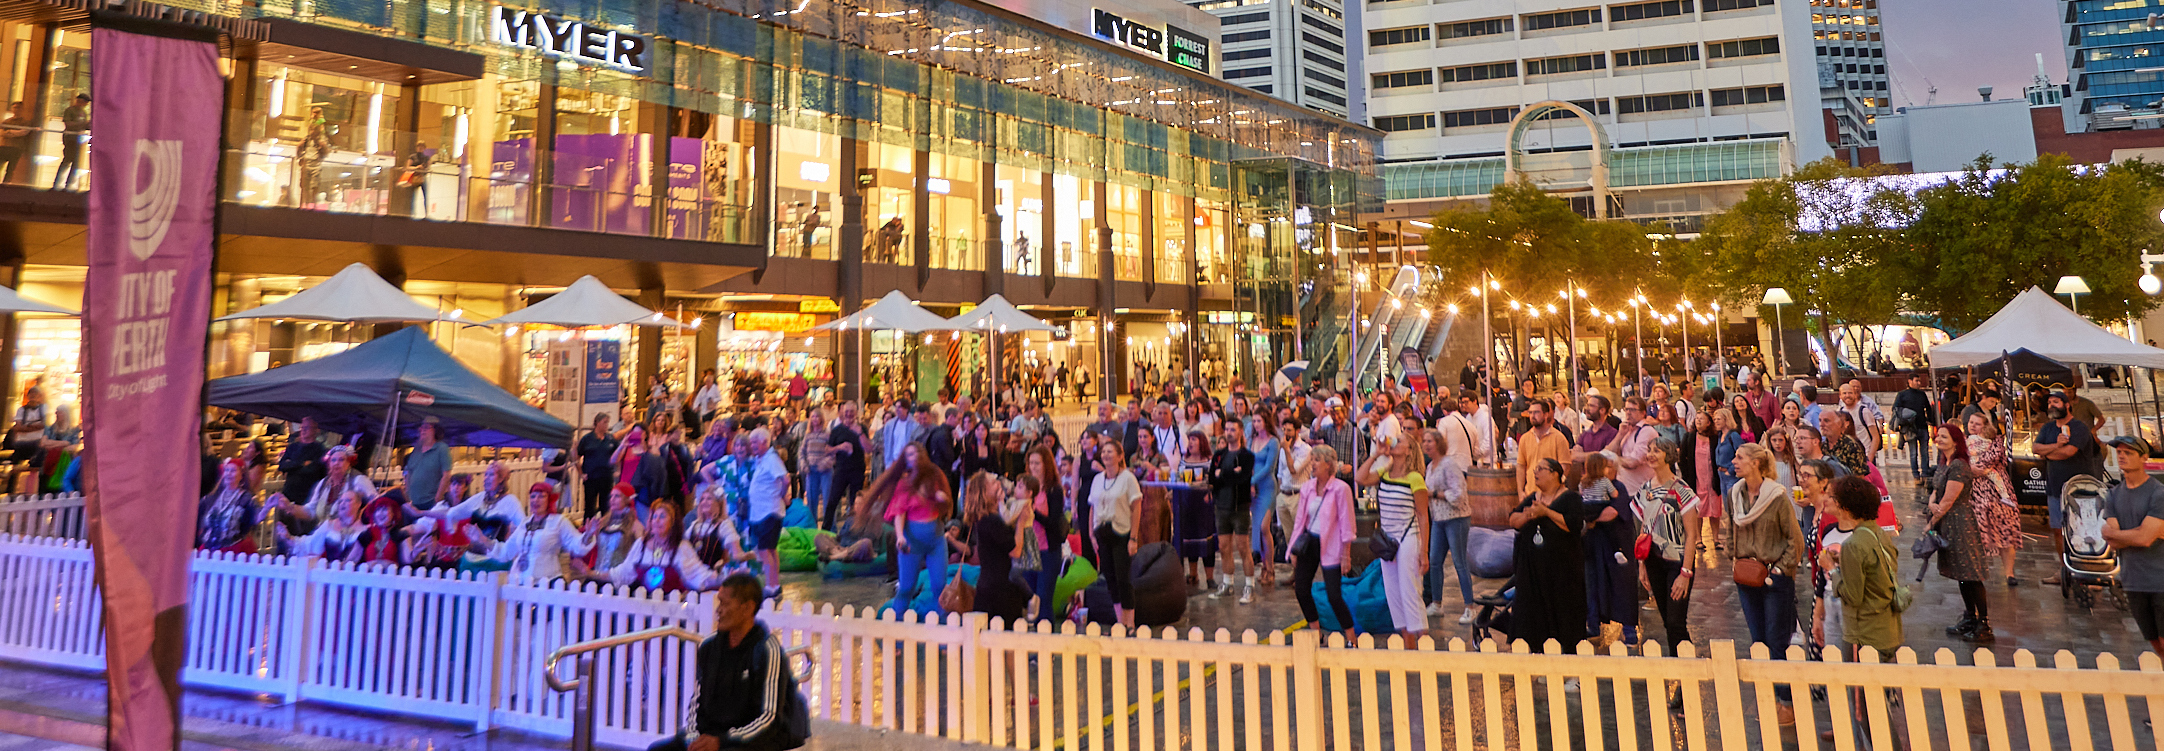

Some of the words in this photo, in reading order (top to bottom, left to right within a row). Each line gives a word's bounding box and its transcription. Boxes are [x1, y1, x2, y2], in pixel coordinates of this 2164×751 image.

[491, 5, 644, 71] MYER
[1090, 7, 1163, 57] MYER
[1174, 34, 1206, 56] FORREST
[1177, 52, 1203, 70] CHASE
[117, 272, 152, 319] ITY
[2018, 372, 2050, 380] CREAM
